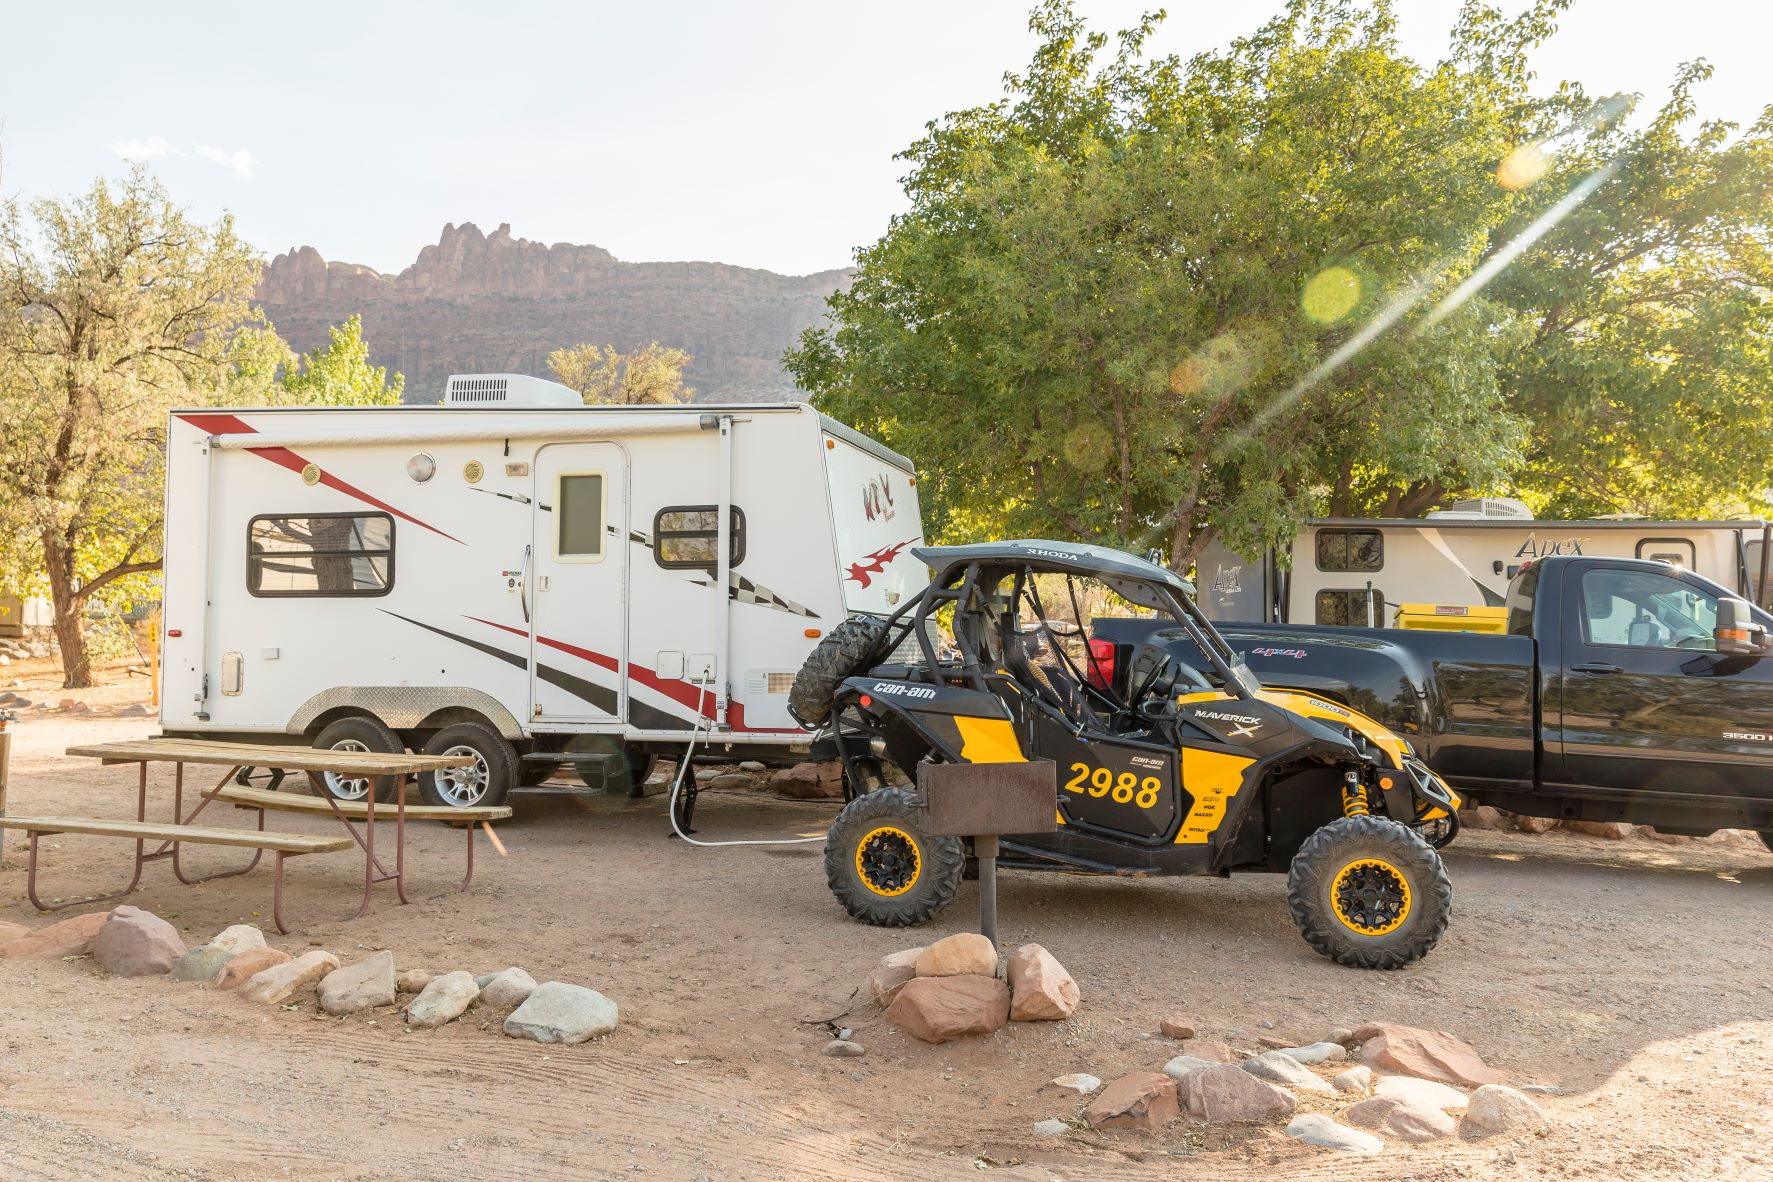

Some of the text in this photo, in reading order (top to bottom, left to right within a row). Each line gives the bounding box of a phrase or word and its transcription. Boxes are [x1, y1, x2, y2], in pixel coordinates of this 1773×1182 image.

[1026, 548, 1078, 561] RHODA
[1194, 709, 1262, 725] MAVERICK
[1722, 732, 1766, 741] 3500
[1064, 762, 1162, 809] 2988
